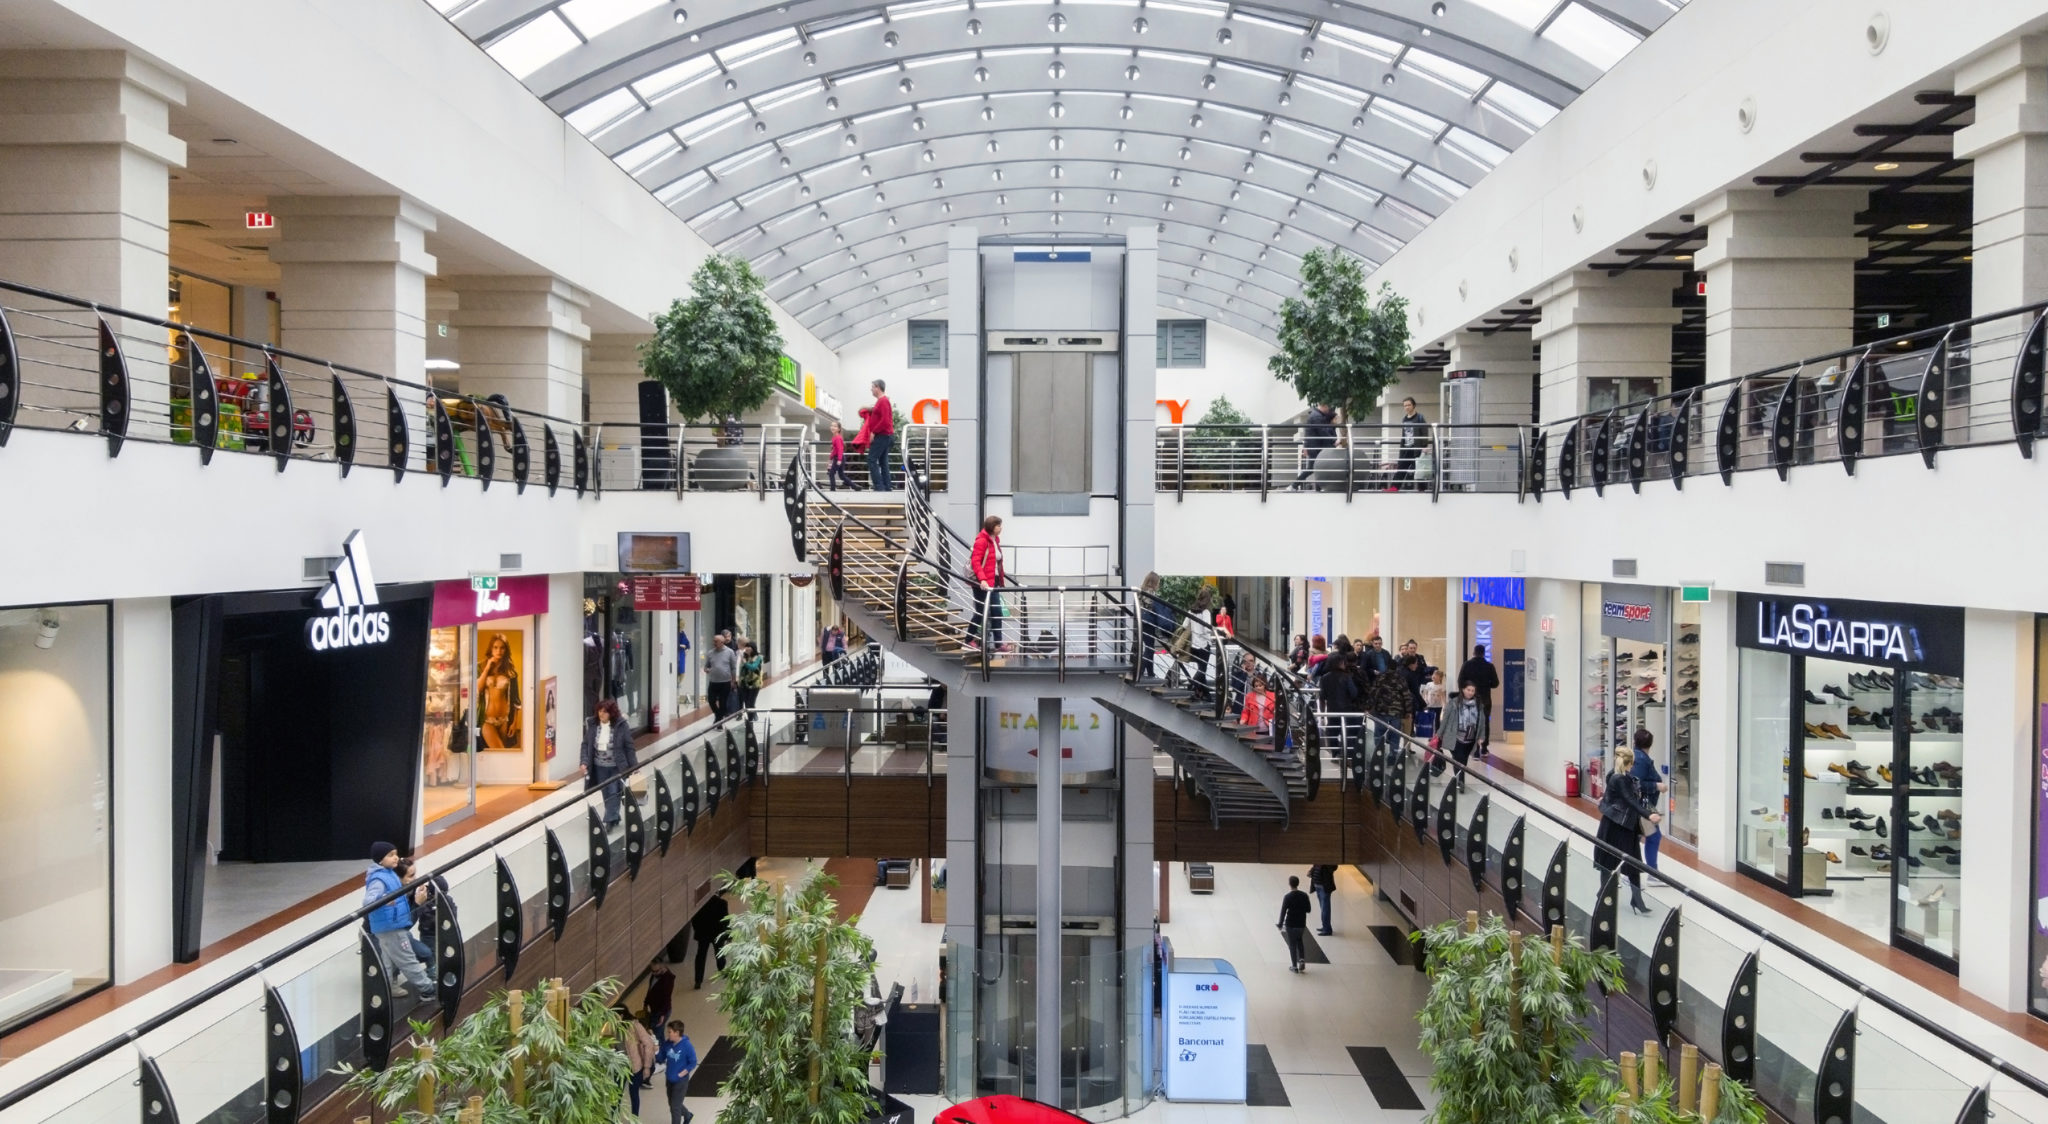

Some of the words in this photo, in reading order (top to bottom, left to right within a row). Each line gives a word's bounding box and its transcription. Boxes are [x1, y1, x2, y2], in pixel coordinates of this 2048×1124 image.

[1603, 600, 1651, 621] teamsport
[311, 605, 390, 651] adidas
[1090, 712, 1100, 730] 2
[1195, 984, 1211, 992] BCR
[1178, 1037, 1225, 1047] Bancomat
